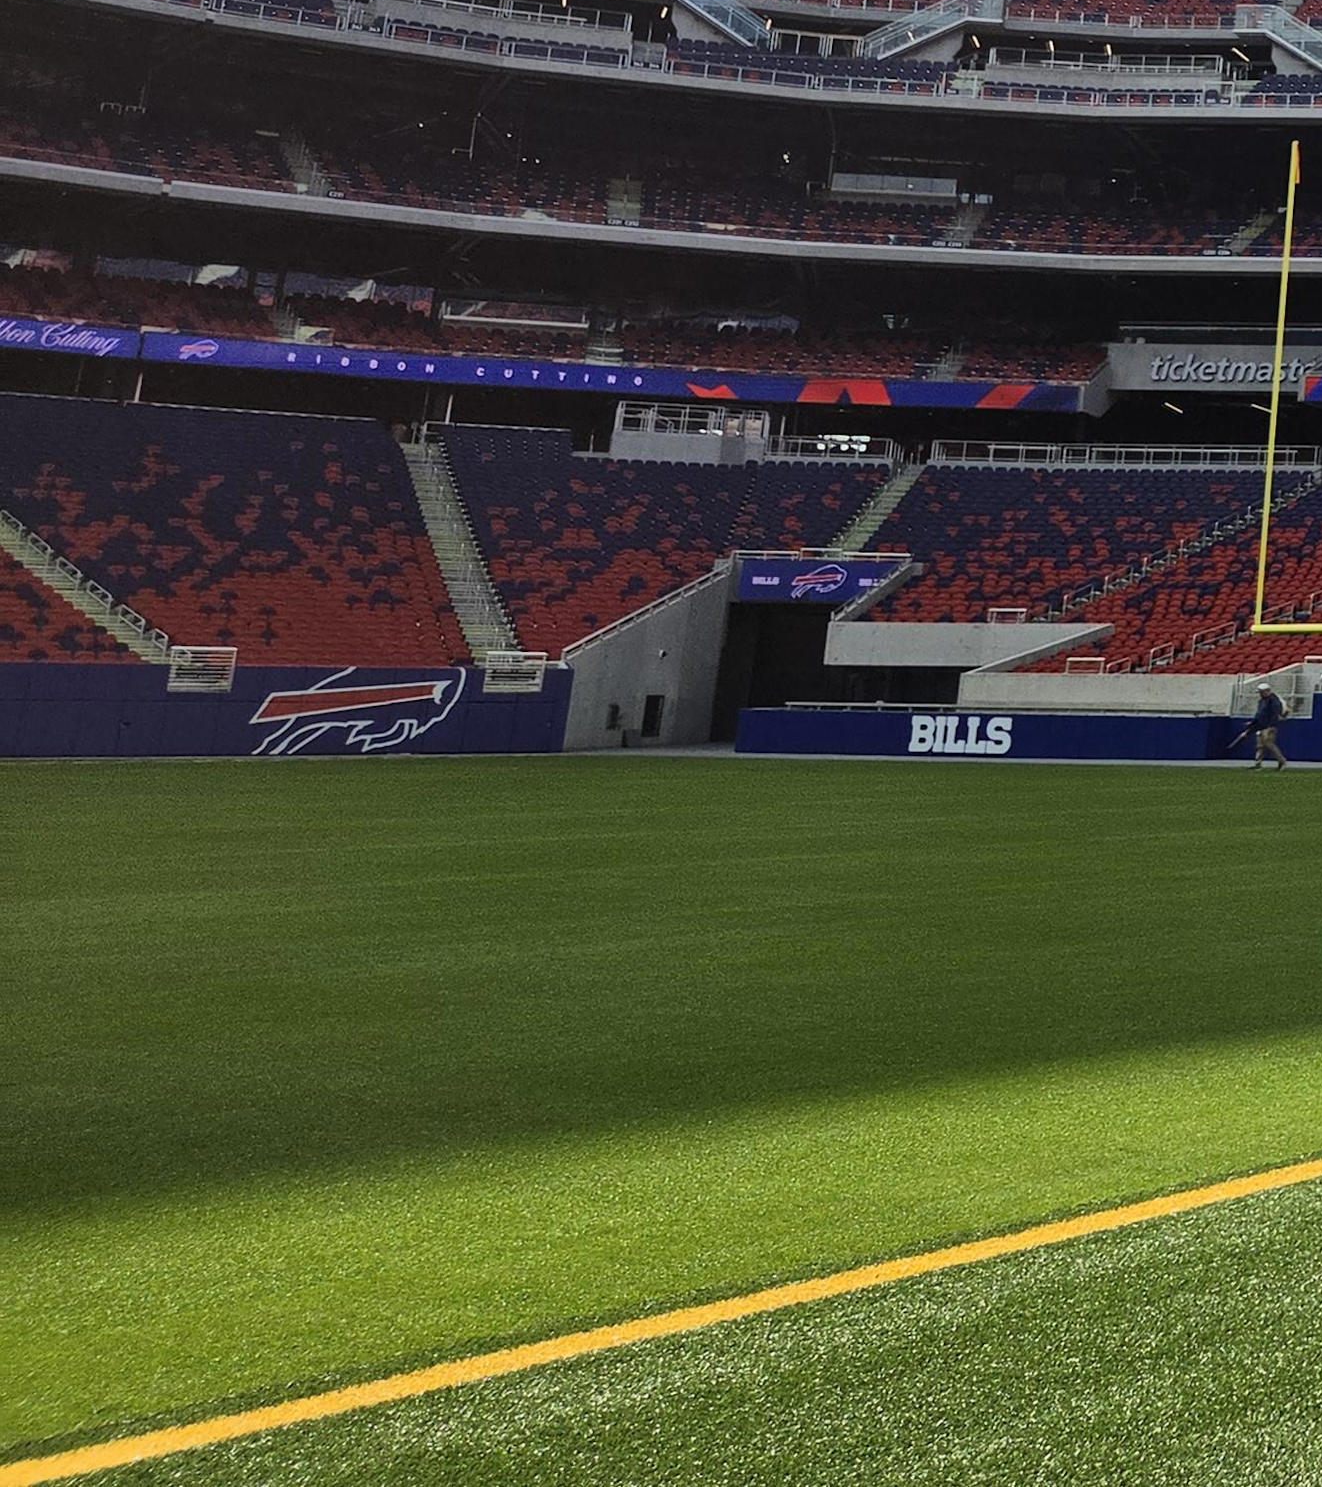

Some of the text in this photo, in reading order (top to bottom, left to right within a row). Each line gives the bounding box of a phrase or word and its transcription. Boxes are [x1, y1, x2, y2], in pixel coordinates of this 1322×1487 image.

[40, 322, 121, 357] Cutting
[286, 352, 644, 387] RIBBON CUTTING
[908, 714, 1013, 755] BILLS
